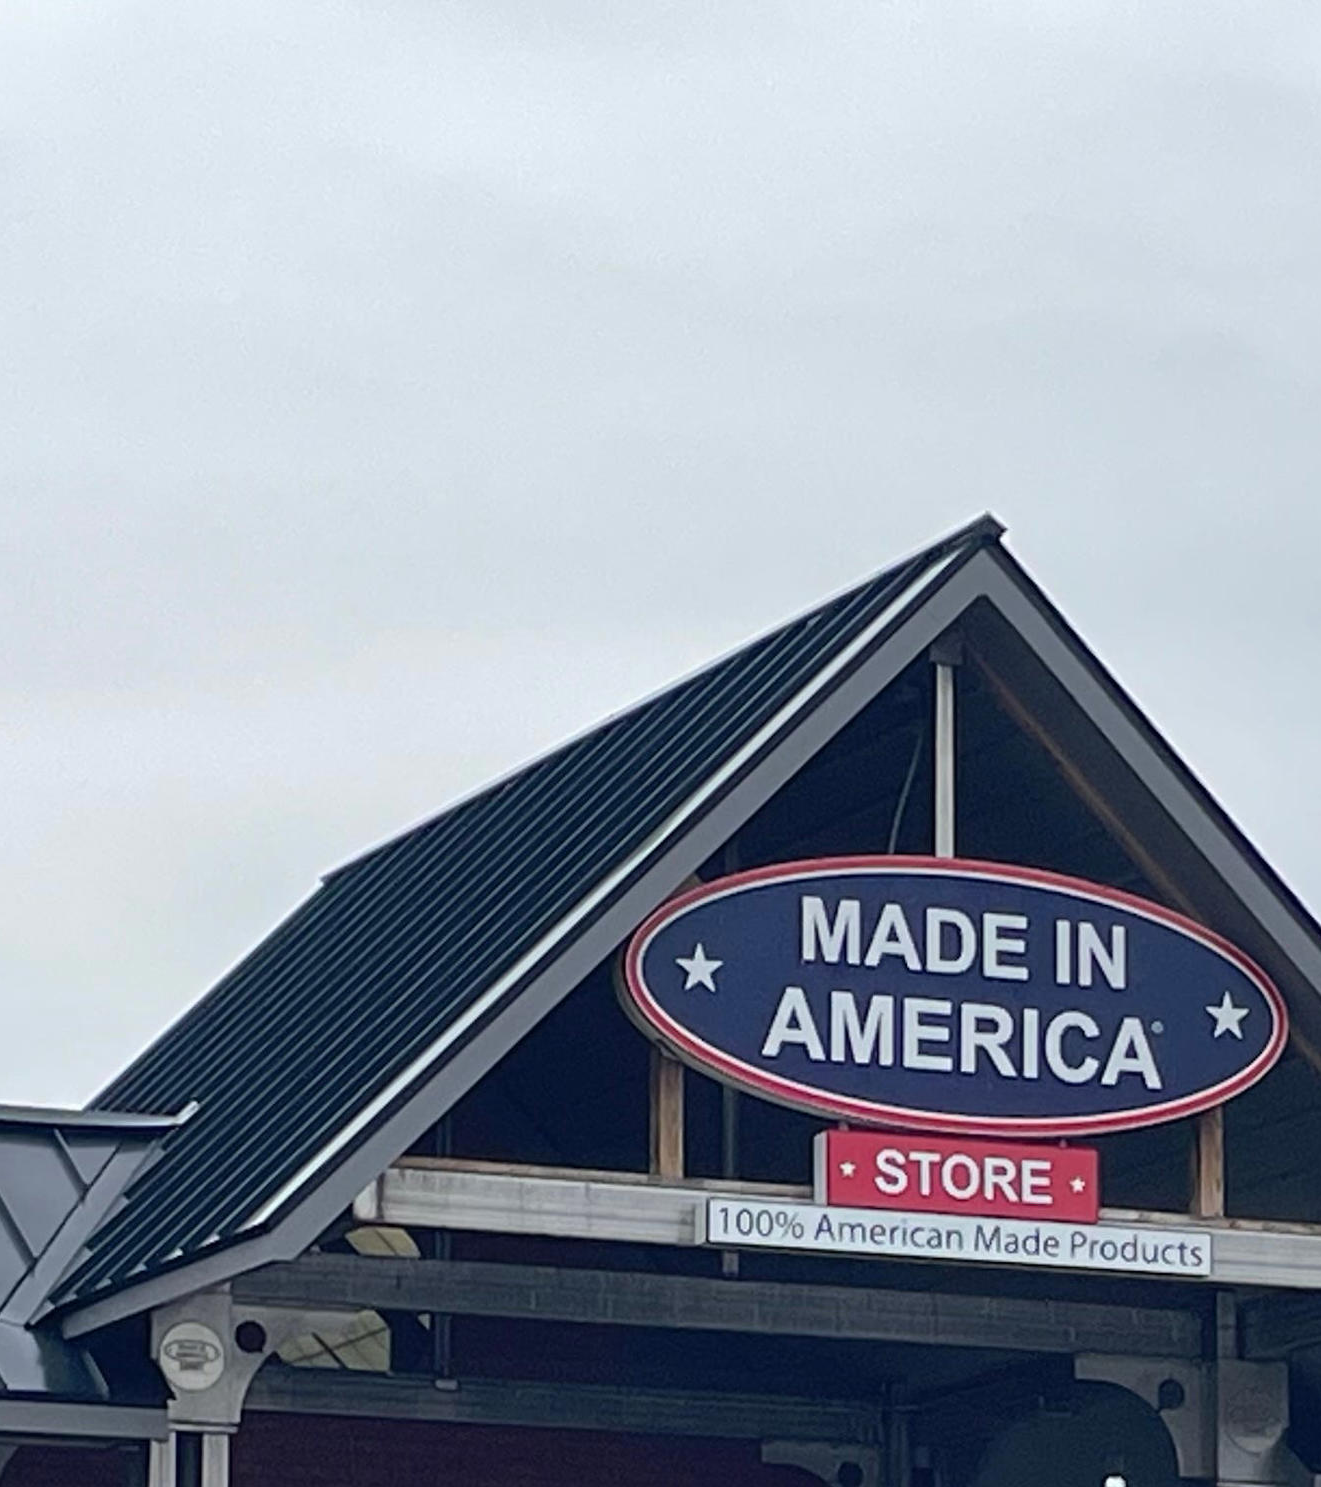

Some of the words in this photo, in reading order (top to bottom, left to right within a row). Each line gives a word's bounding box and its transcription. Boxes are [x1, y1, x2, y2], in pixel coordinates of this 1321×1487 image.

[801, 895, 1029, 981] MADE
[1055, 920, 1127, 990] IN
[761, 986, 1162, 1091] AMERICA
[874, 1148, 1053, 1205] STORE
[719, 1207, 804, 1240] 100%
[814, 1213, 963, 1249] American
[973, 1224, 1060, 1257] Made
[1070, 1231, 1204, 1268] Products
